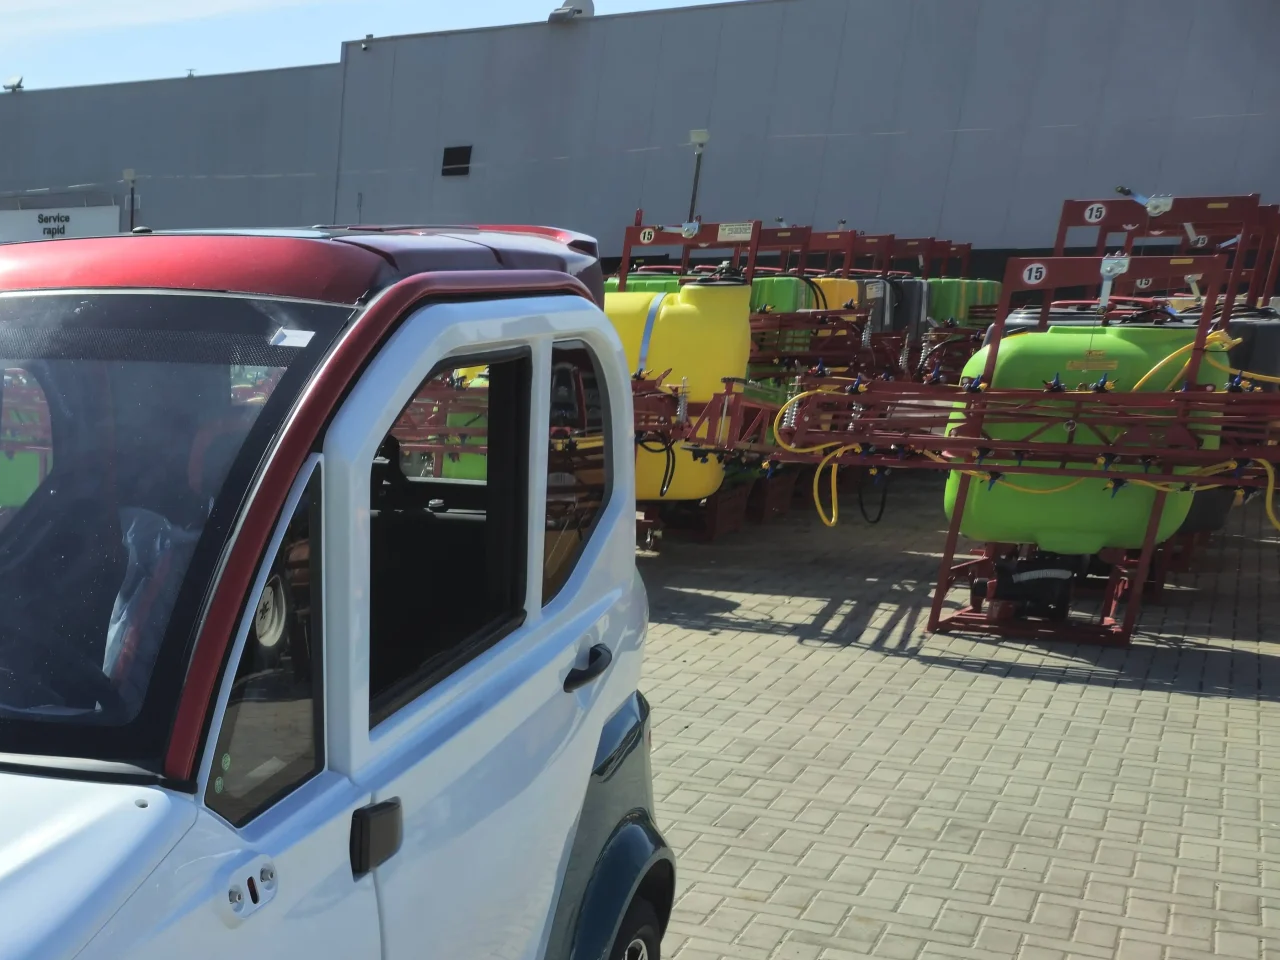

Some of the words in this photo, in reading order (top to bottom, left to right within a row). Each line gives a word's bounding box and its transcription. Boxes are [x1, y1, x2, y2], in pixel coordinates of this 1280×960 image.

[37, 213, 70, 223] Service
[1086, 206, 1104, 219] 15
[42, 225, 66, 238] rapid
[642, 231, 653, 241] 15
[1025, 267, 1044, 281] 15
